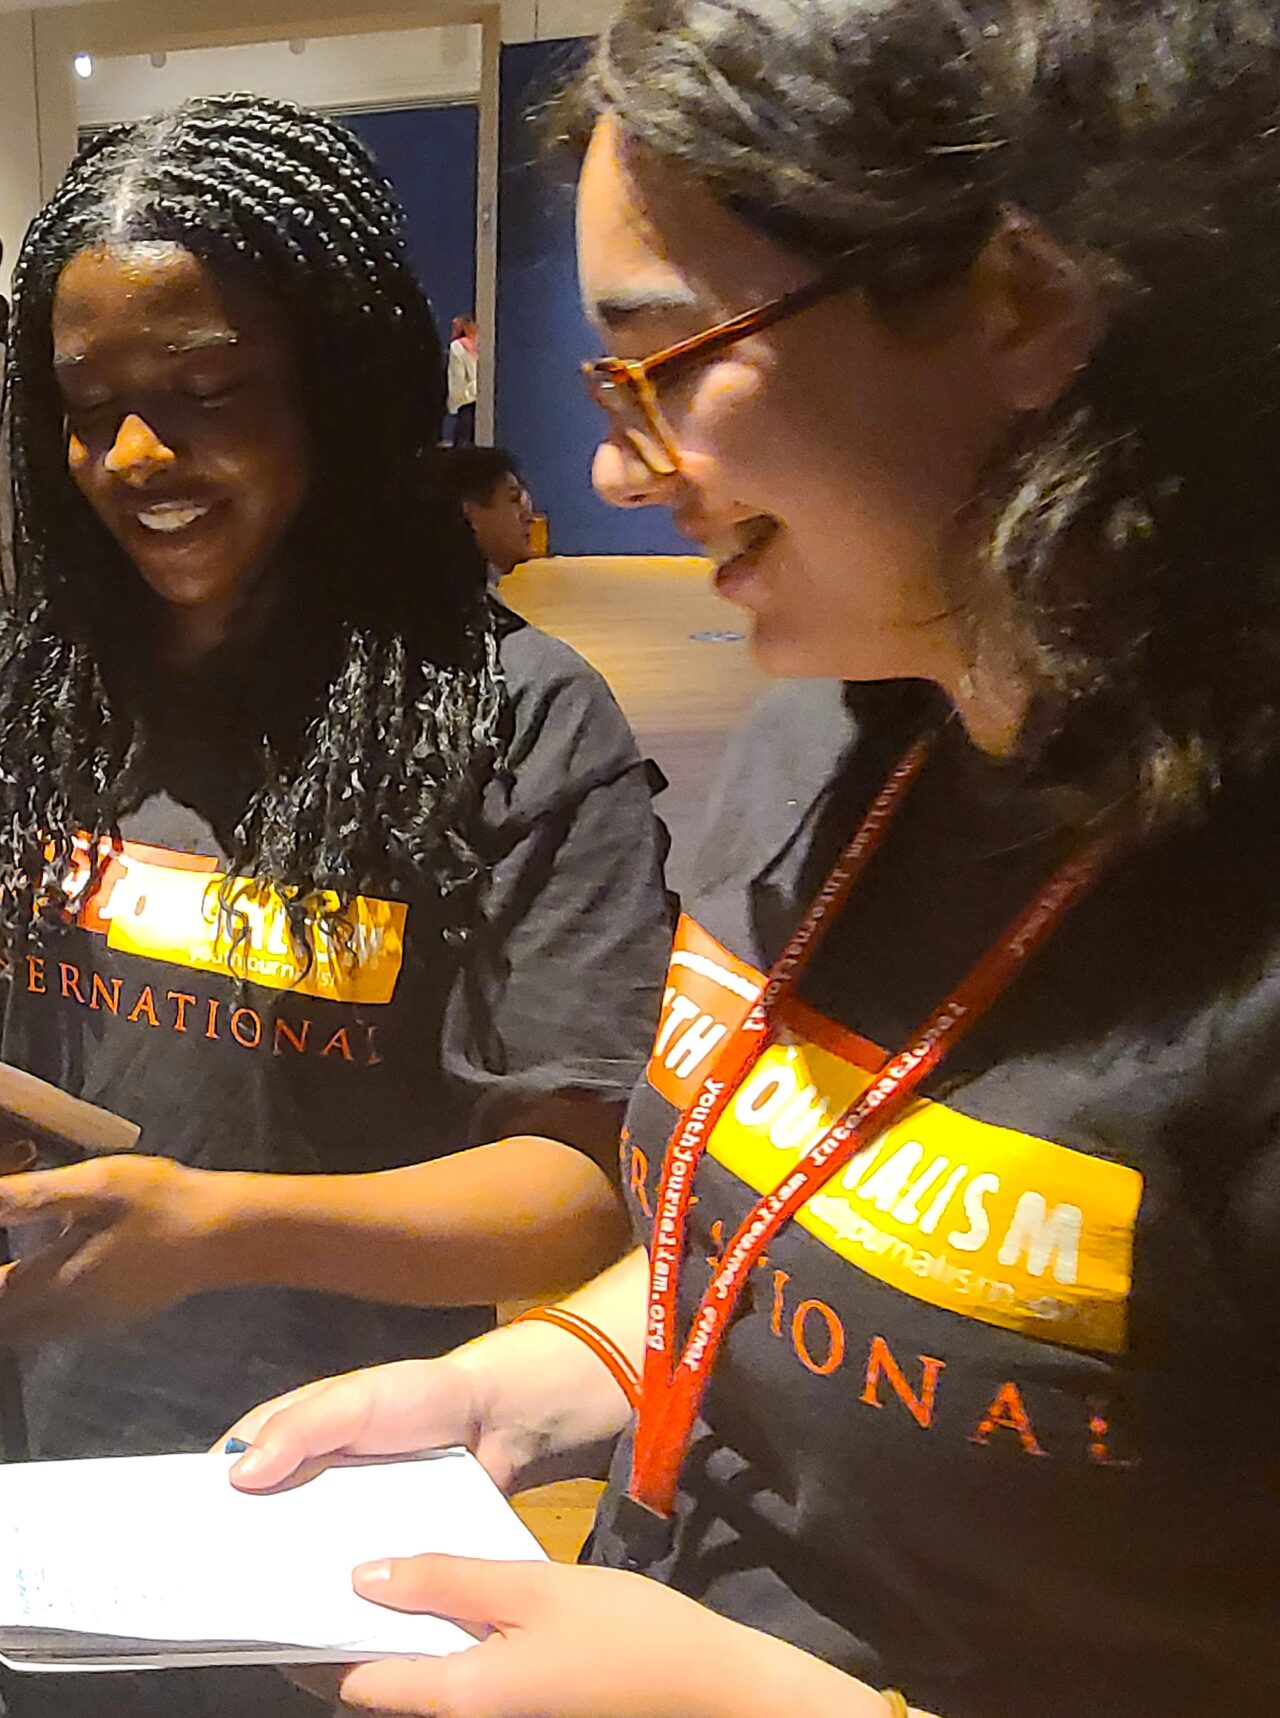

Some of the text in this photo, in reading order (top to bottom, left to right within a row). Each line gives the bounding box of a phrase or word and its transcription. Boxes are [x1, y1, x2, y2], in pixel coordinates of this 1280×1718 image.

[23, 953, 384, 1066] ERNATIONAL
[650, 1077, 725, 1351] youthjournalism.org
[713, 1169, 808, 1299] Journalism
[733, 1052, 1083, 1285] OUALISM
